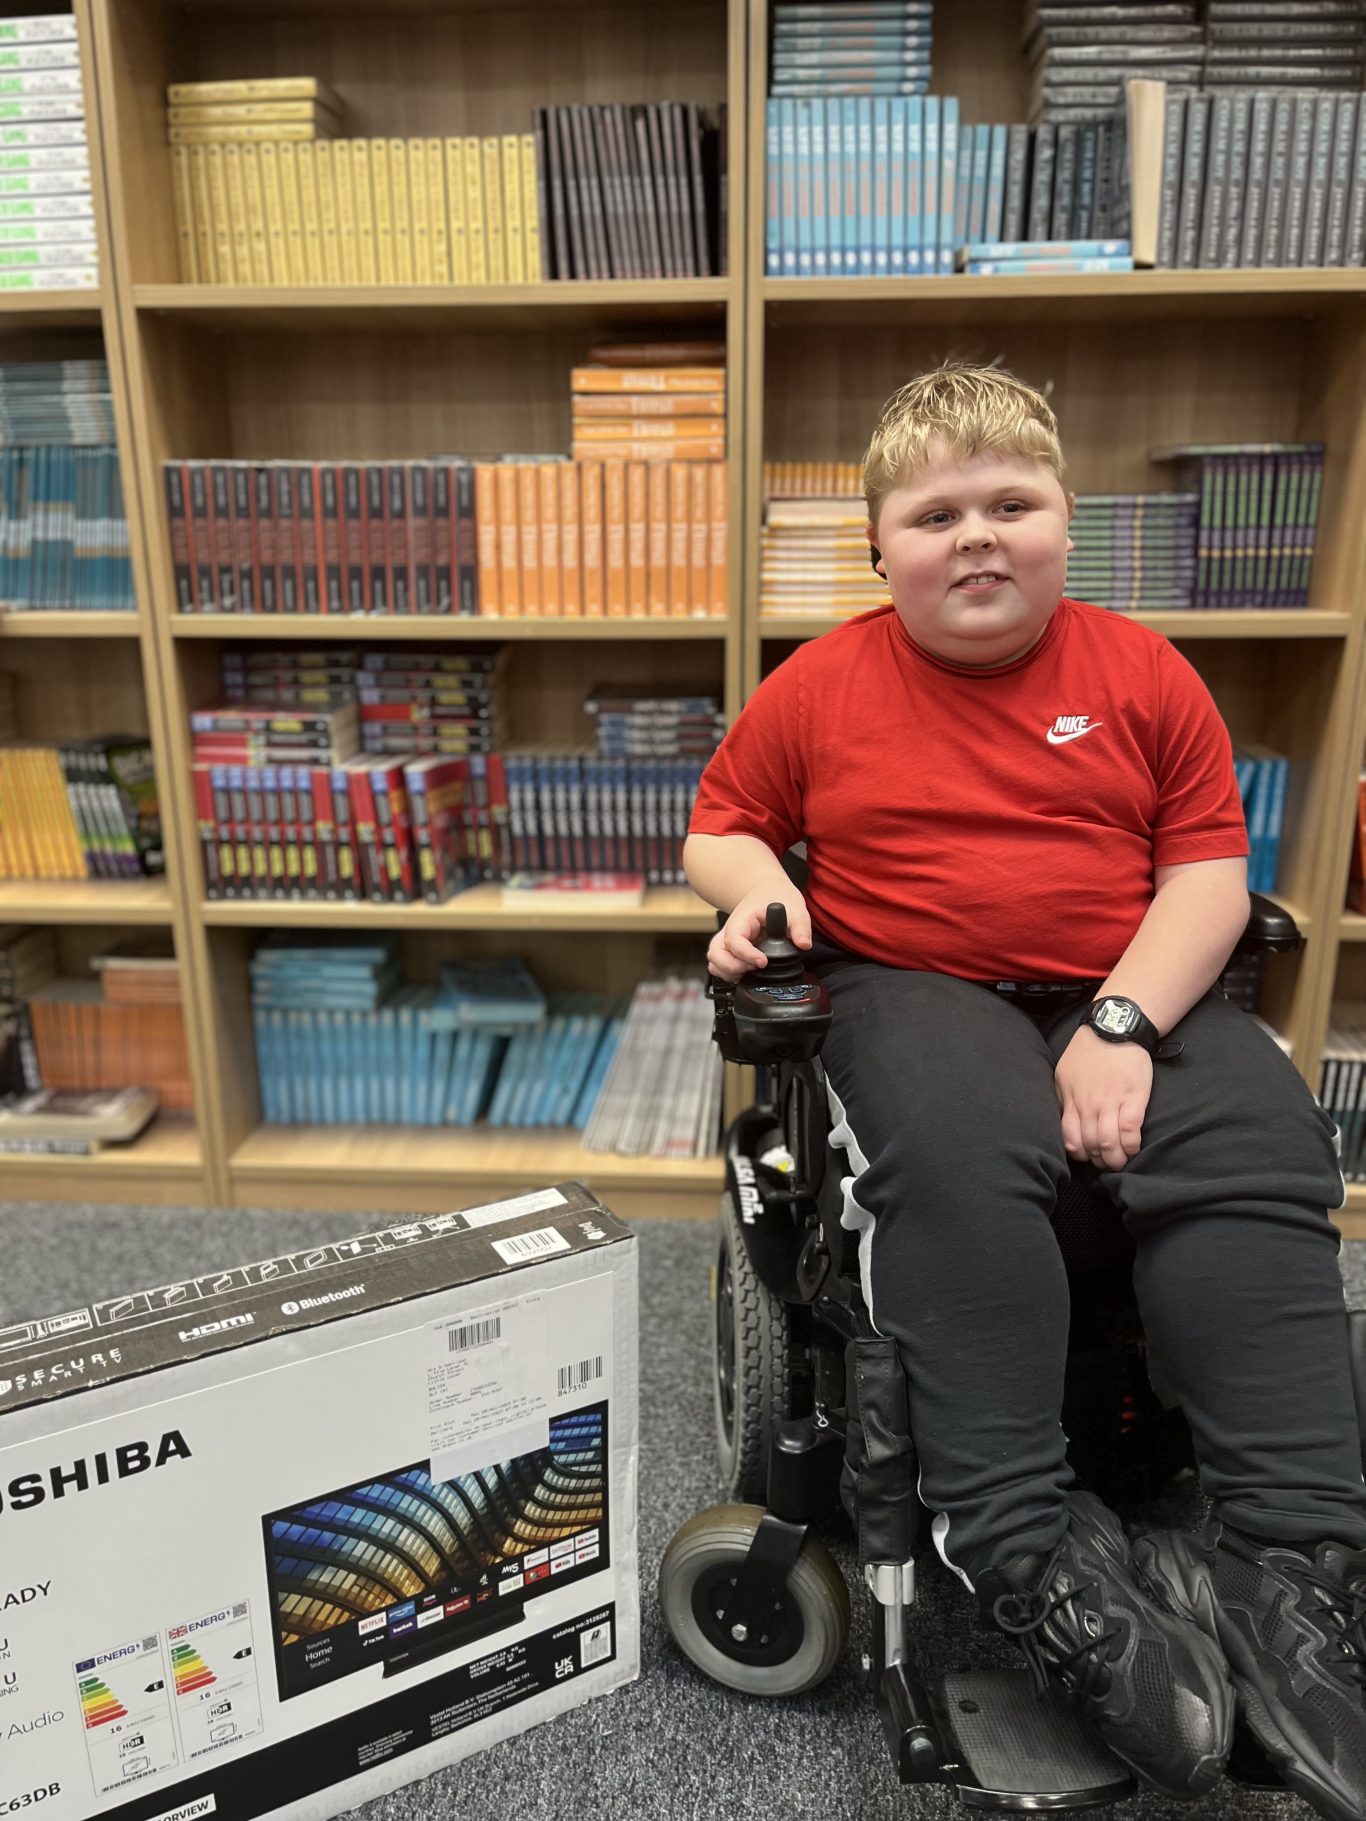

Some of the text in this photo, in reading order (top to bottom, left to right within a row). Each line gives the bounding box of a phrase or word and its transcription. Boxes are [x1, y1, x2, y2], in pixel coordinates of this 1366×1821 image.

[1053, 715, 1089, 732] NIKE
[299, 1285, 362, 1310] Bluetooth
[178, 1312, 254, 1341] HDMI
[15, 1348, 122, 1384] SECURE
[15, 1356, 122, 1391] SMART TV
[0, 1430, 192, 1514] SHIBA
[0, 1580, 51, 1611] ADY
[188, 1612, 226, 1632] ENERG
[361, 1617, 384, 1630] NETFLIX
[552, 1626, 575, 1639] catalog
[96, 1645, 136, 1665] ENERG
[305, 1646, 333, 1662] Home
[555, 1655, 573, 1670] UK
[555, 1664, 573, 1678] CA
[199, 1691, 211, 1701] 16
[7, 1710, 64, 1740] Audio
[110, 1725, 122, 1735] 16
[157, 1800, 209, 1821] ORVIEW
